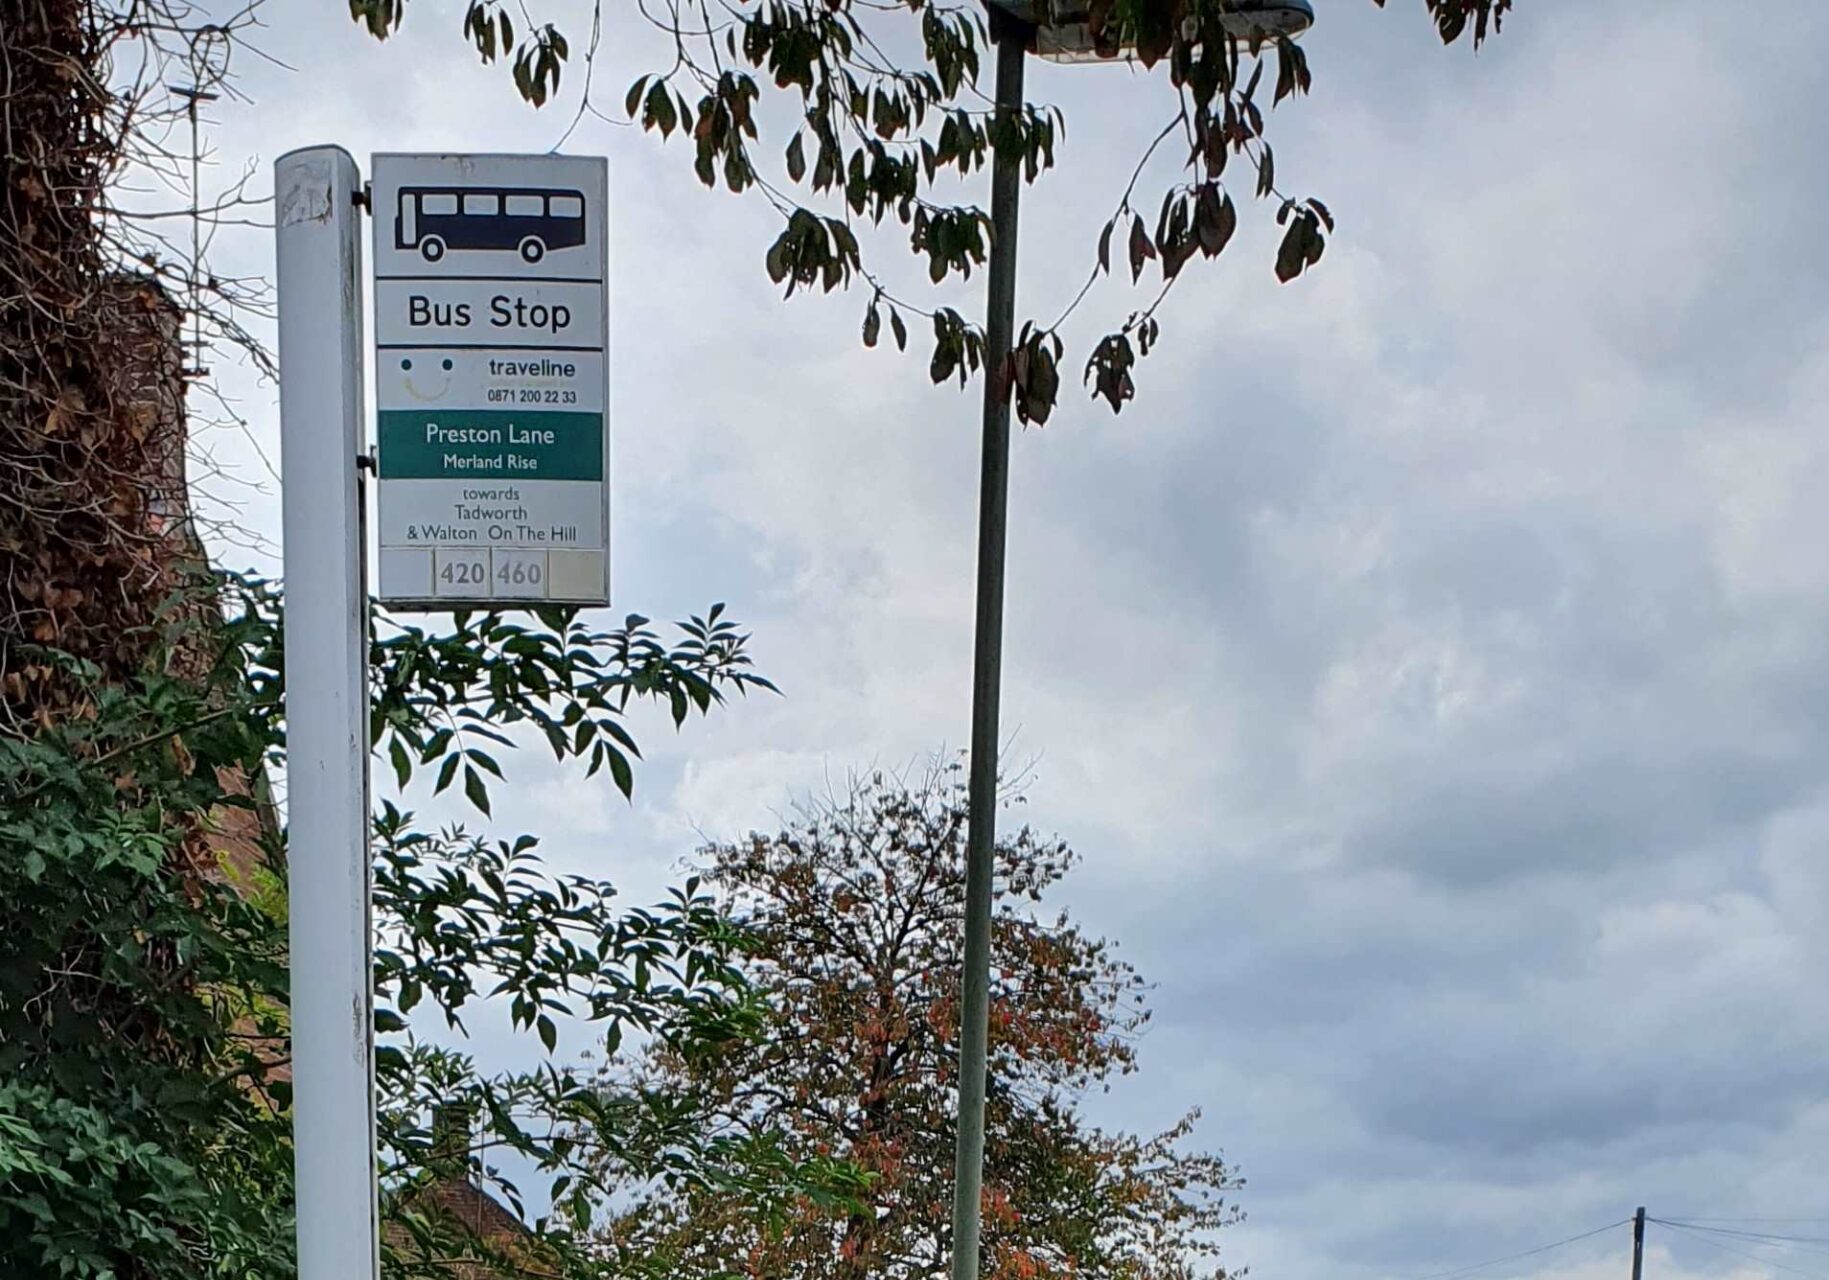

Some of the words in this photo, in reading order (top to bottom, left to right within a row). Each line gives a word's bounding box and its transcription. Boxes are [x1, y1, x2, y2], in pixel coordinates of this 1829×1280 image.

[409, 295, 471, 326] Bus
[490, 295, 571, 333] Stop
[489, 358, 576, 377] traveline
[487, 389, 516, 402] 0871
[519, 389, 541, 403] 200
[544, 390, 560, 403] 22
[562, 391, 577, 404] 33
[426, 423, 501, 443] Preston
[508, 424, 555, 444] Lane
[443, 453, 502, 469] Merland
[507, 455, 538, 469] Rise
[463, 486, 520, 500] towards
[454, 504, 528, 520] Tadworth
[407, 525, 419, 540] &
[421, 525, 477, 540] Walton
[488, 525, 513, 540] On
[516, 526, 546, 541] The
[551, 526, 576, 541] Hill
[440, 562, 485, 584] 420
[496, 562, 542, 584] 460
